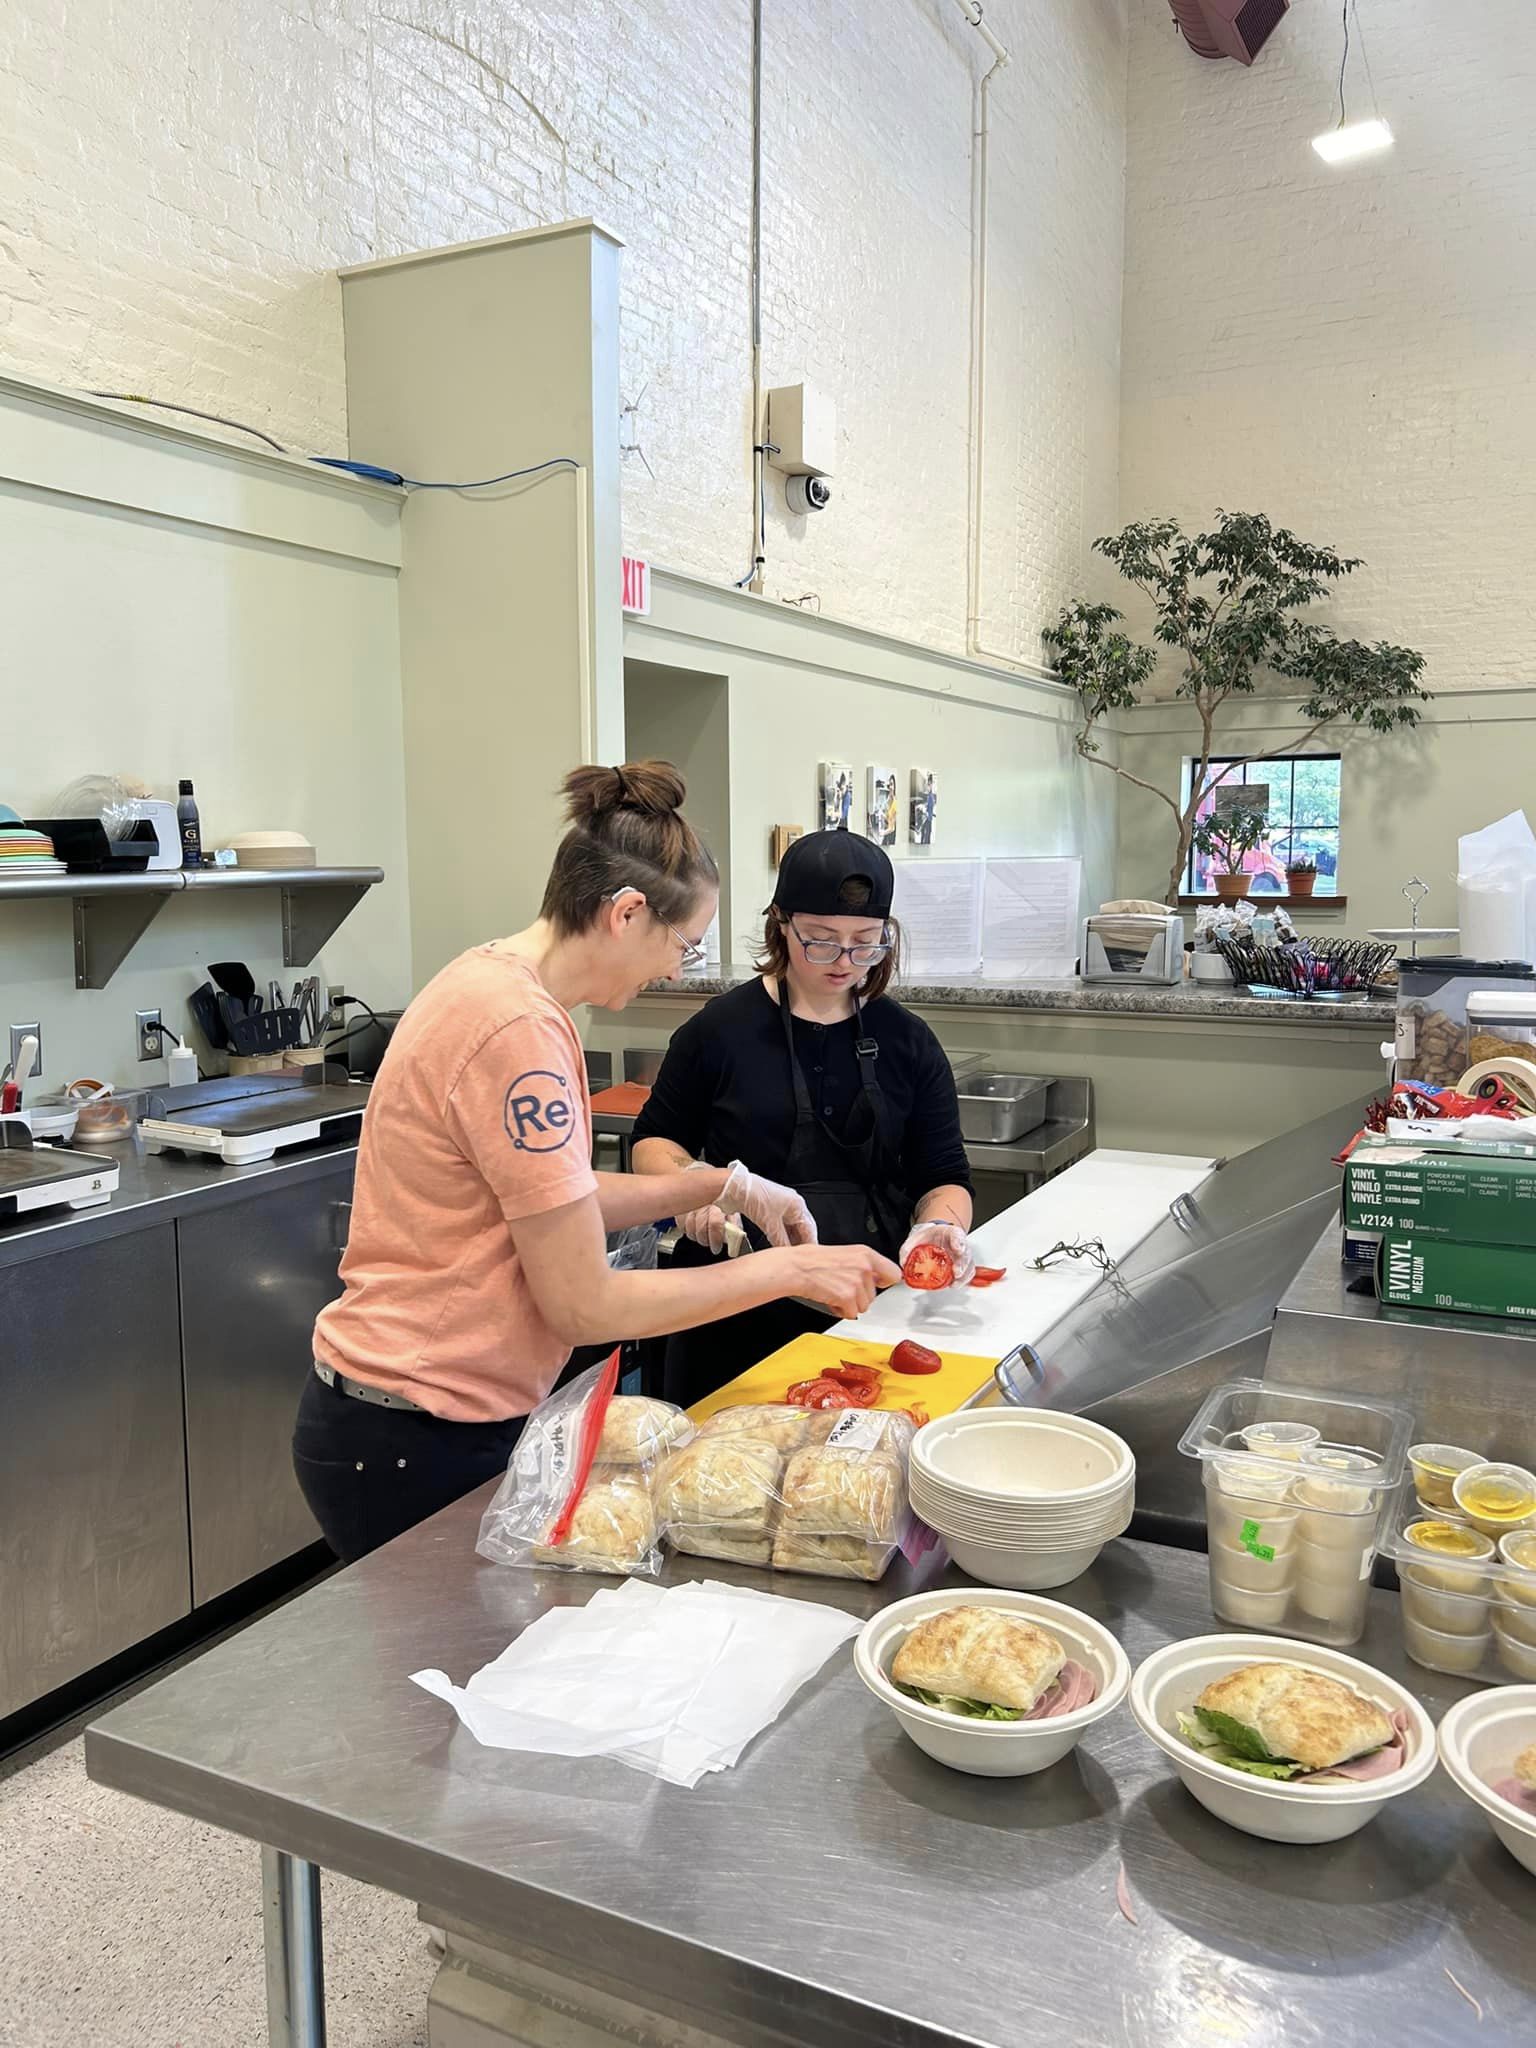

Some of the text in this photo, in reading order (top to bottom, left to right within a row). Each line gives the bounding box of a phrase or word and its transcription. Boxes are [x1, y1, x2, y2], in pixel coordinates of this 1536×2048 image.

[622, 556, 645, 609] XIT
[510, 1095, 569, 1138] Re
[1351, 1167, 1377, 1180] VINYL
[1351, 1180, 1380, 1193] VINILO
[1351, 1192, 1382, 1205] VINYLE
[1360, 1214, 1394, 1228] V2124
[1399, 1218, 1414, 1229] 100
[1389, 1240, 1412, 1290] VINYL
[1412, 1256, 1424, 1293] MEDIUM
[1389, 1291, 1411, 1301] GLOVES
[1434, 1294, 1452, 1306] 100
